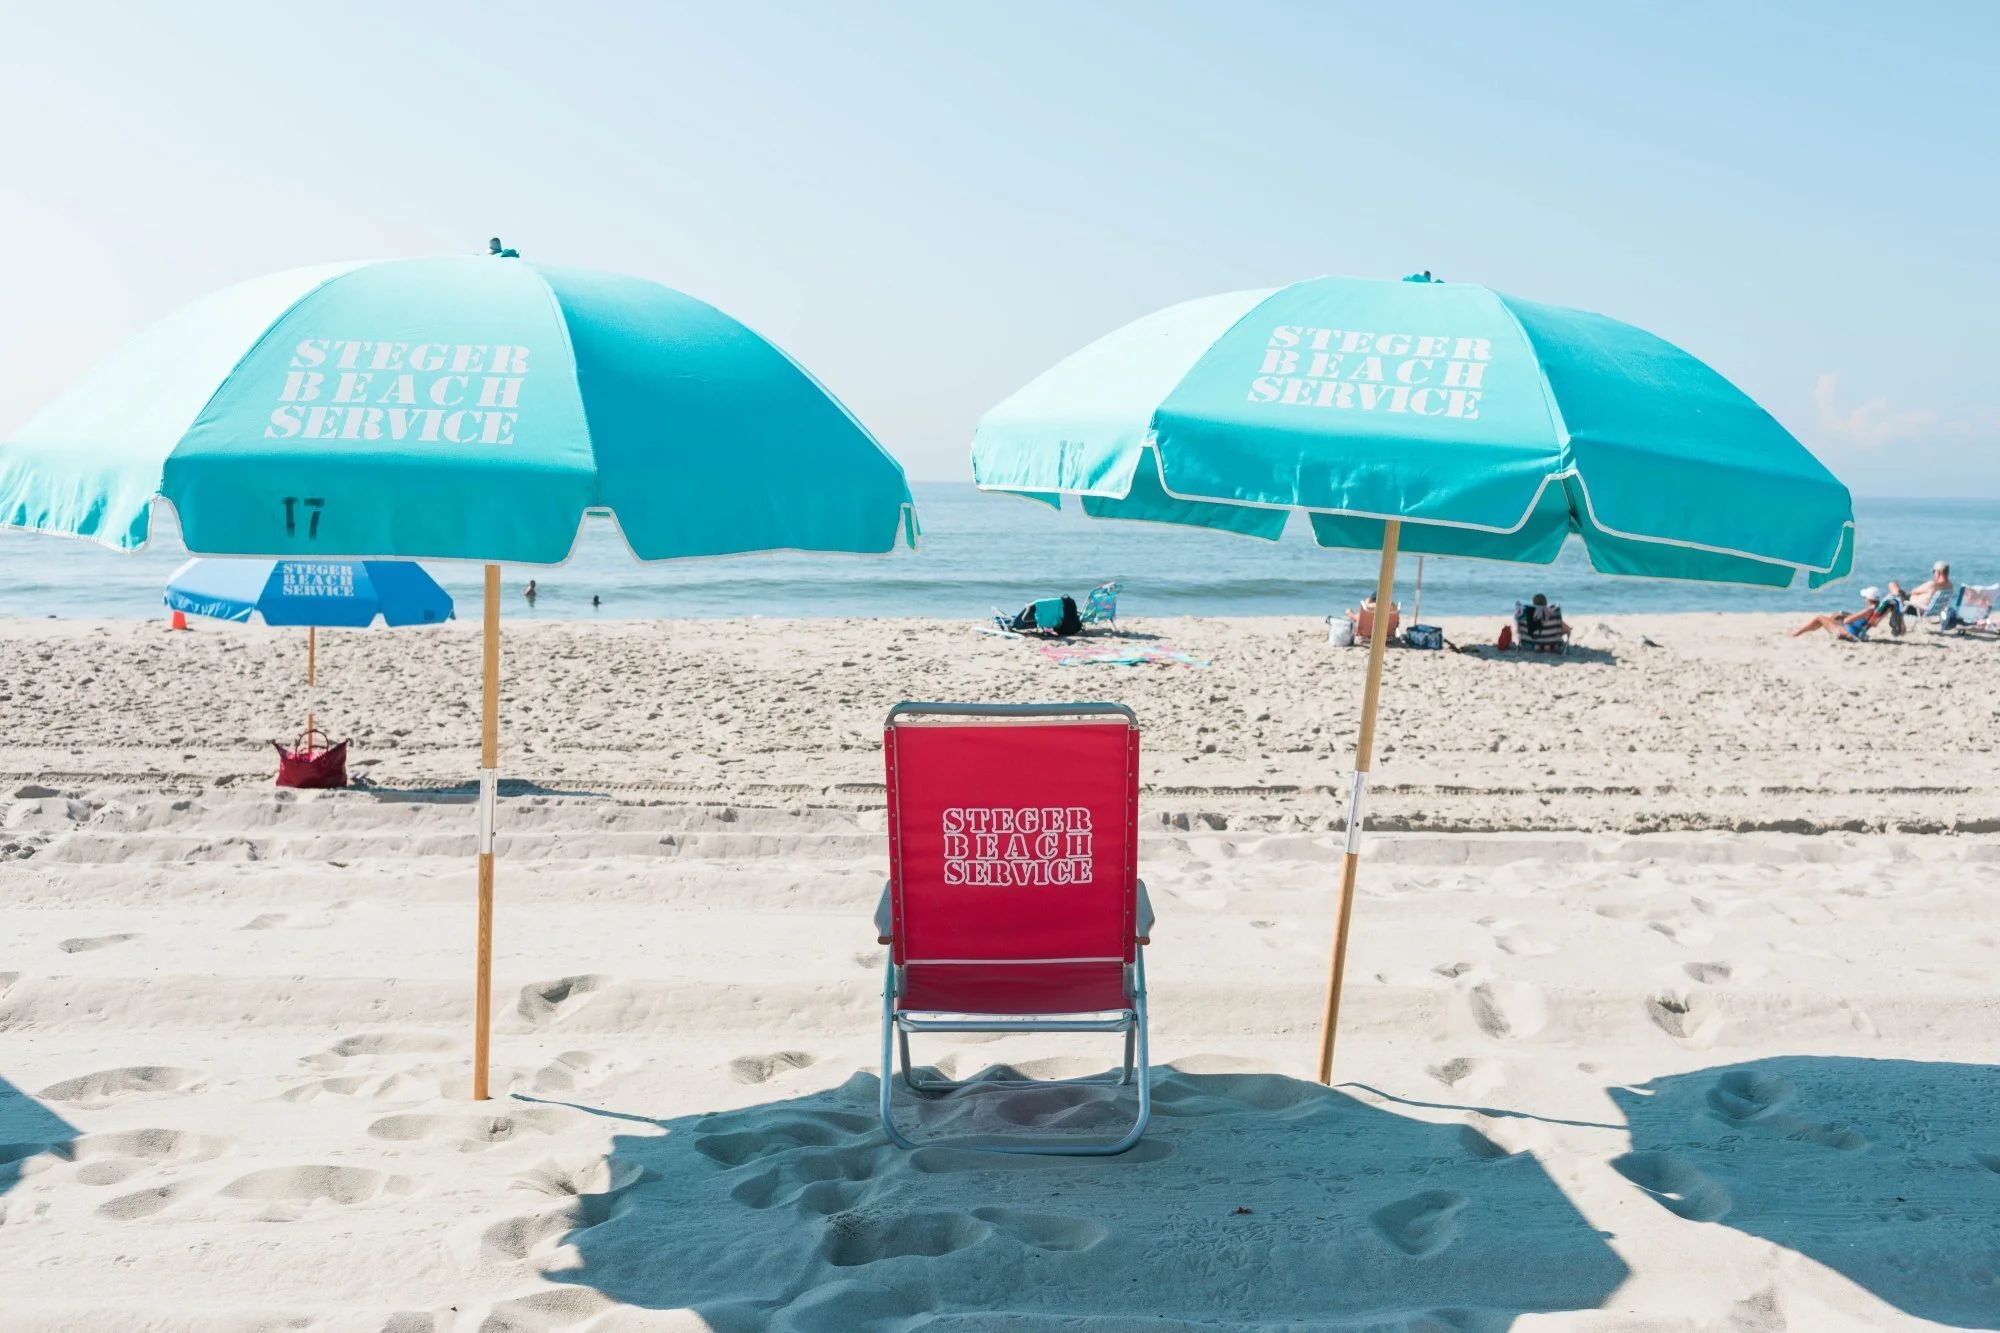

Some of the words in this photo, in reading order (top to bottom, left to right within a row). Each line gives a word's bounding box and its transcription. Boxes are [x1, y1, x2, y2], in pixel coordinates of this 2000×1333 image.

[290, 339, 531, 374] STEGER
[1267, 325, 1493, 361] STEGER
[1258, 349, 1488, 389] BEACH
[277, 371, 525, 408] BEACH
[1247, 376, 1482, 419] SERVICE
[264, 405, 519, 445] SERVICE
[281, 496, 326, 540] 17
[283, 563, 354, 576] STEGER
[283, 574, 353, 586] BEACH
[282, 584, 355, 597] SERVICE
[943, 807, 1093, 834] STEGER
[944, 832, 1093, 860] BEACH
[944, 858, 1093, 886] SERVICE
